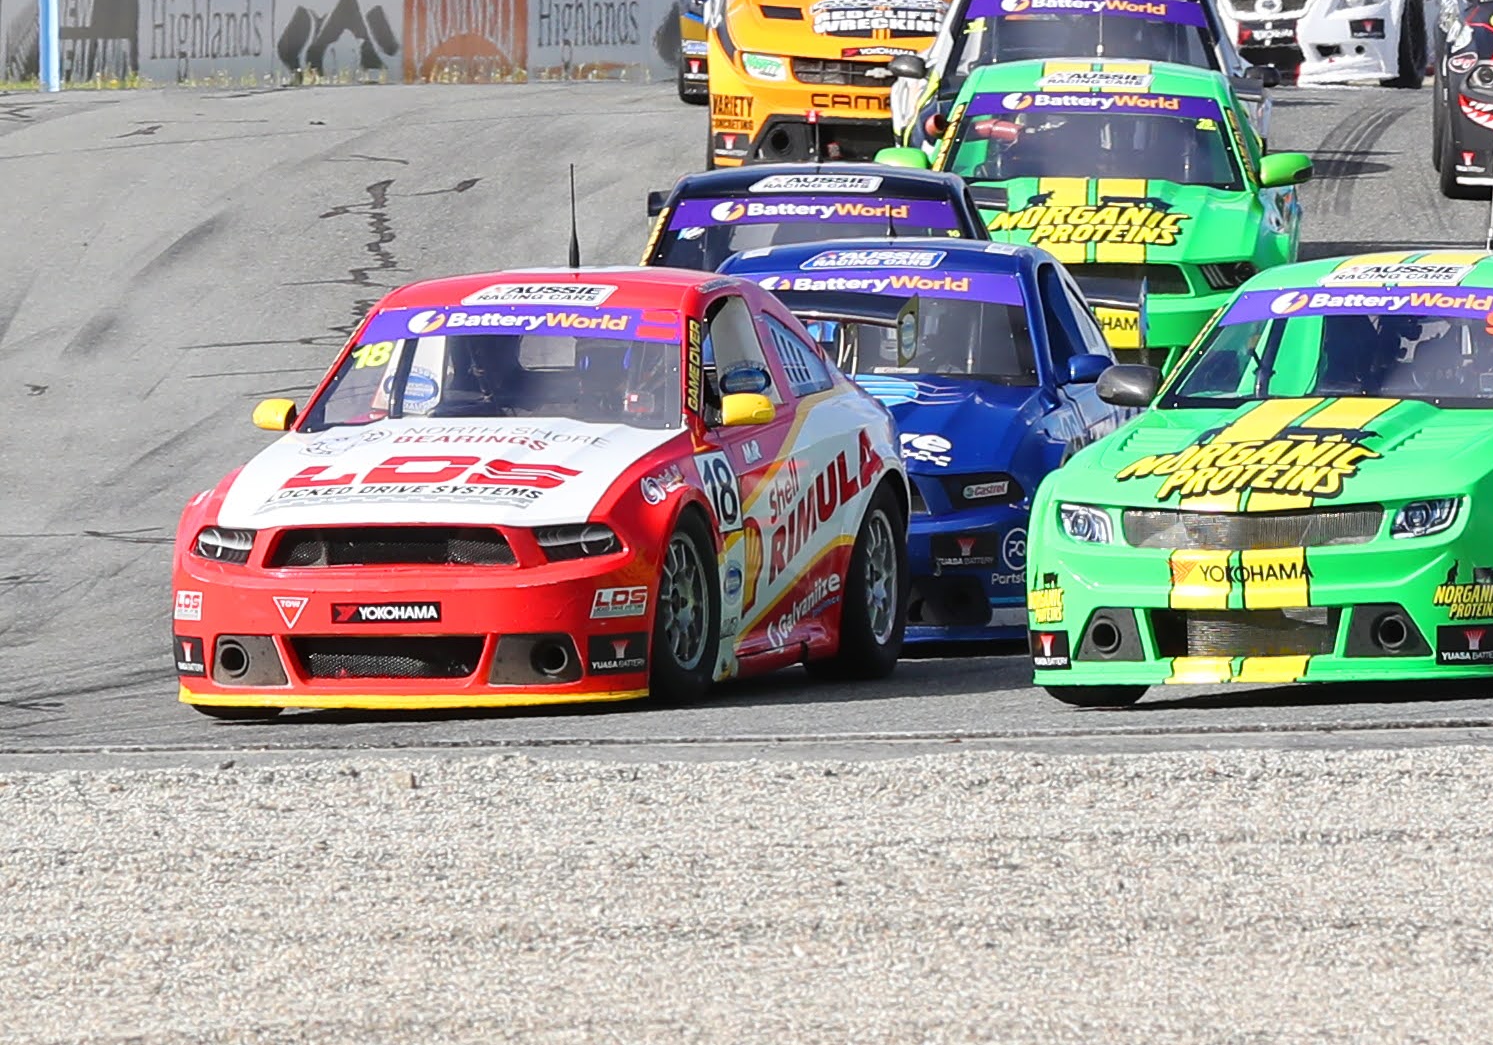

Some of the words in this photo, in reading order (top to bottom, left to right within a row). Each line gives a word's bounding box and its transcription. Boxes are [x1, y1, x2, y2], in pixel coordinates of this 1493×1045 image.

[1067, 73, 1145, 81] AUSSIE
[712, 94, 754, 117] VARIETY
[1034, 94, 1181, 111] BatteryWorld
[789, 176, 872, 185] AUSSIE
[747, 202, 908, 218] BatteryWorld
[987, 206, 1190, 232] NORGANIC
[1028, 224, 1180, 244] PROTEINS
[836, 251, 940, 259] AUSSIE
[1366, 265, 1464, 274] AUSSIE
[506, 286, 605, 295] AUSSIE
[793, 275, 970, 293] BatteryWorld
[477, 293, 543, 301] RACING
[548, 293, 599, 302] CARS
[445, 311, 631, 331] BatteryWorld
[351, 340, 394, 369] 18
[392, 435, 549, 451] BEARINGS
[402, 426, 496, 436] NORTH
[510, 426, 611, 450] SHORE
[1115, 440, 1381, 479] NORGANIC
[281, 455, 583, 490] LDS
[1155, 463, 1356, 499] PROTEINS
[265, 486, 352, 503] LOCKED
[357, 485, 425, 494] DRIVE
[431, 484, 545, 500] SYSTEMS
[703, 457, 739, 526] 18
[767, 457, 802, 525] Shell
[974, 482, 1006, 496] Castrol
[766, 428, 885, 588] RIMULA
[1199, 561, 1314, 583] YOKOHAMA
[280, 600, 301, 608] TOW
[594, 588, 648, 607] LDS
[358, 604, 439, 620] YOKOHAMA
[591, 660, 618, 669] YUASA
[618, 658, 646, 667] BATTERY
[1441, 651, 1471, 660] YUASA
